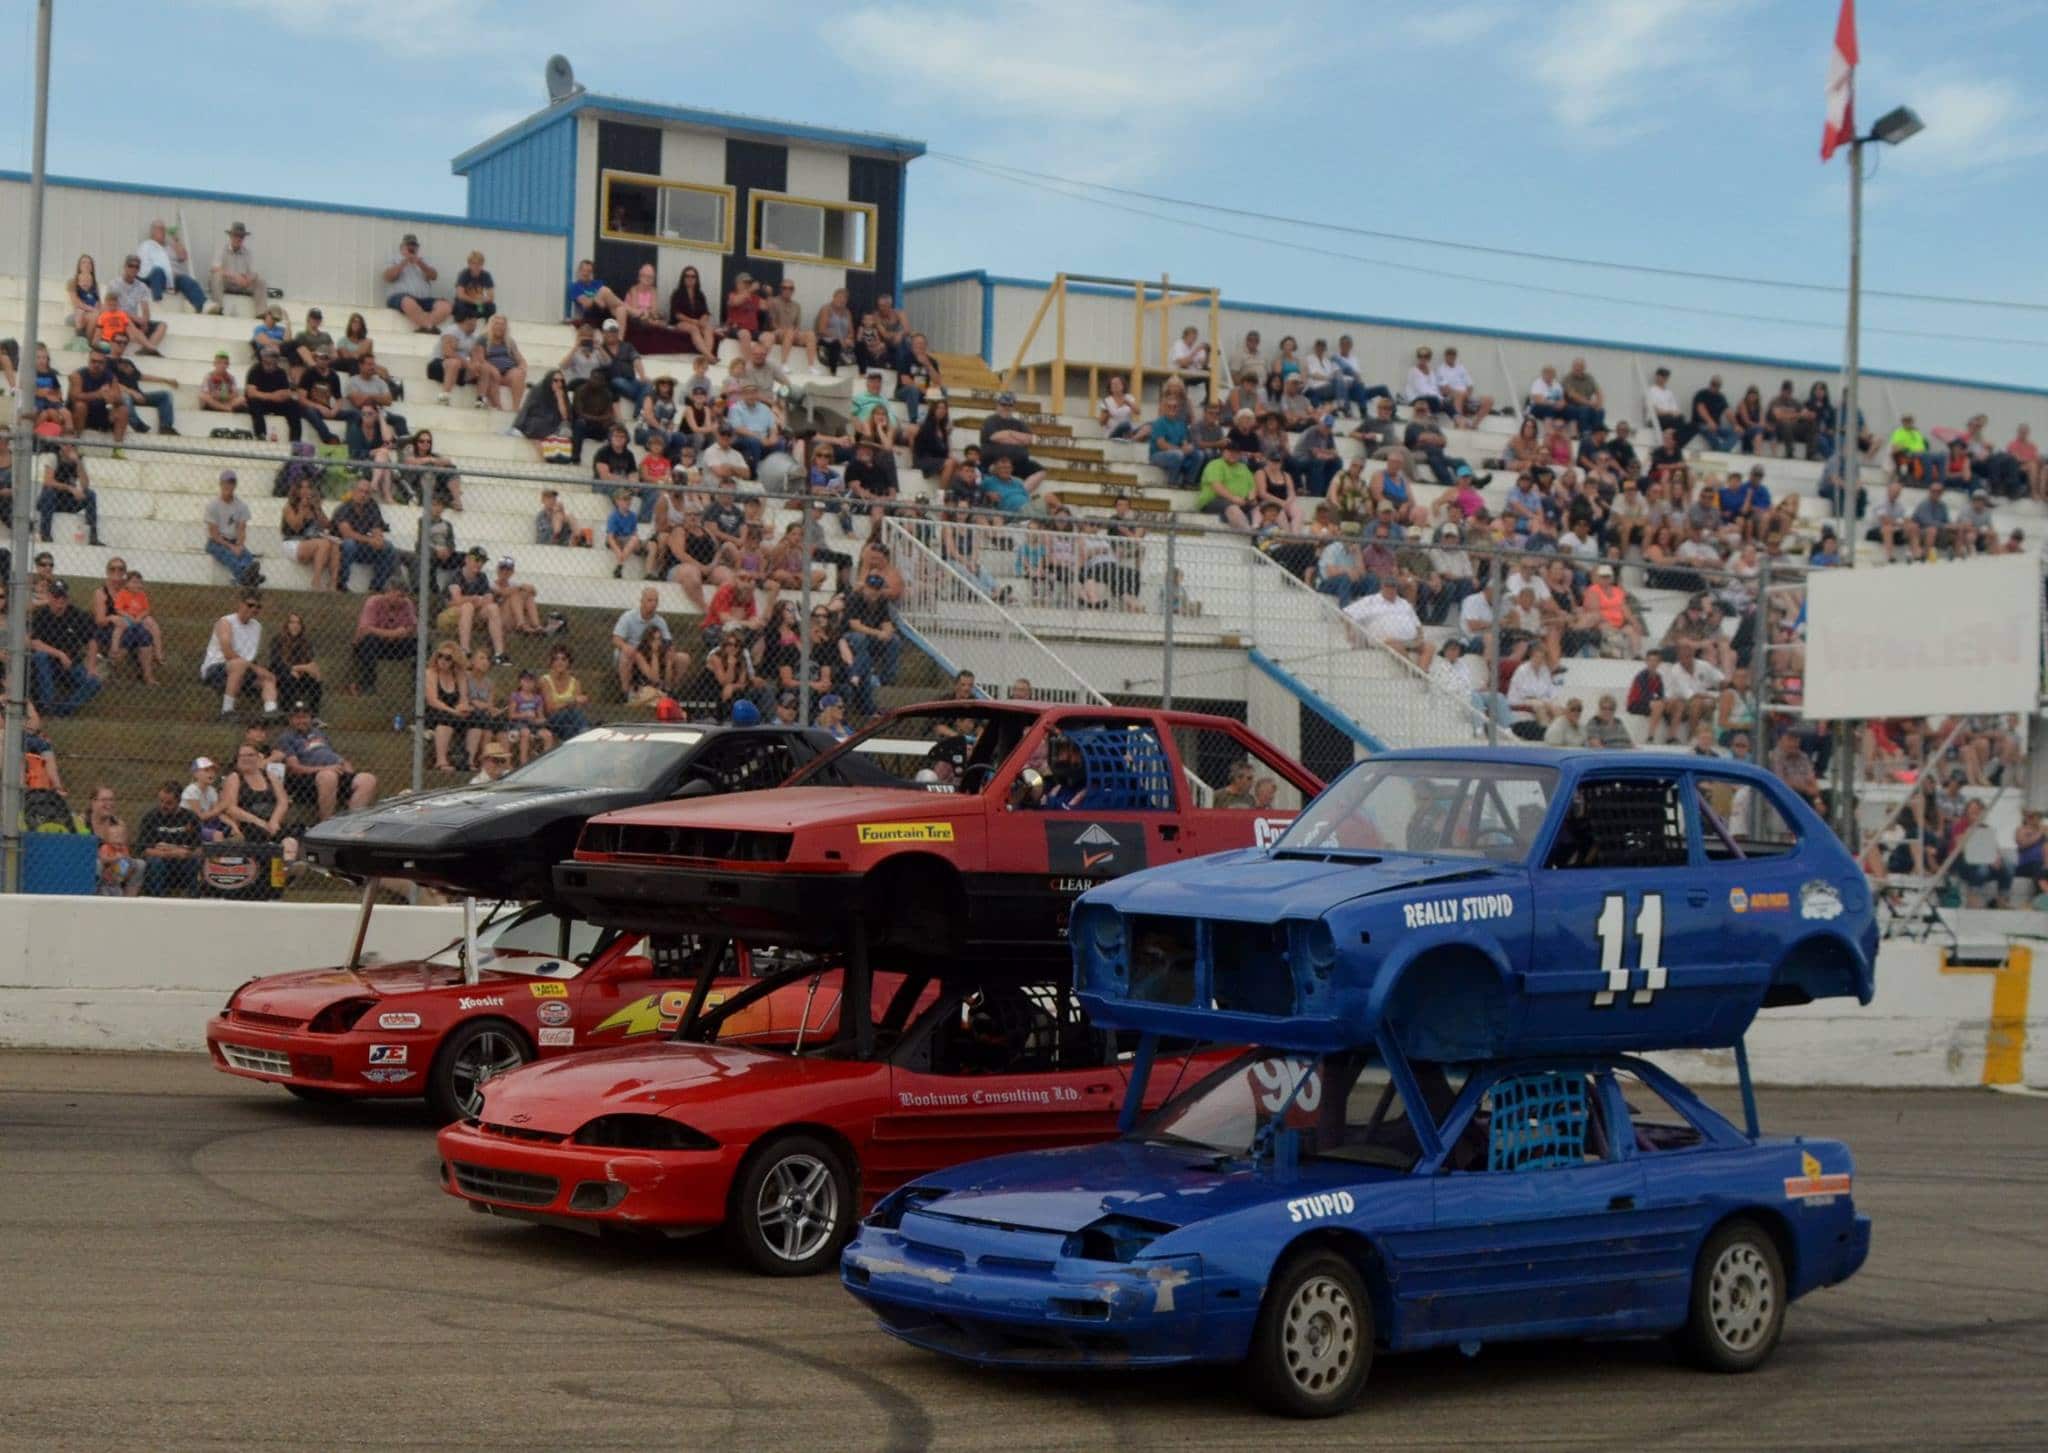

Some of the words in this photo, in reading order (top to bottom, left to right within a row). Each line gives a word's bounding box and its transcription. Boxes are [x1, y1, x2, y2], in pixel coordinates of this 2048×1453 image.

[862, 826, 924, 840] Fountain
[925, 825, 951, 838] Tire
[1048, 878, 1093, 891] CLEAR
[1403, 898, 1458, 929] REALLY
[1462, 893, 1514, 921] STUPID
[1593, 893, 1668, 1006] 11
[972, 1087, 1050, 1104] Consulting
[1051, 1086, 1082, 1101] Ltd.
[1287, 1191, 1355, 1223] STUPID
